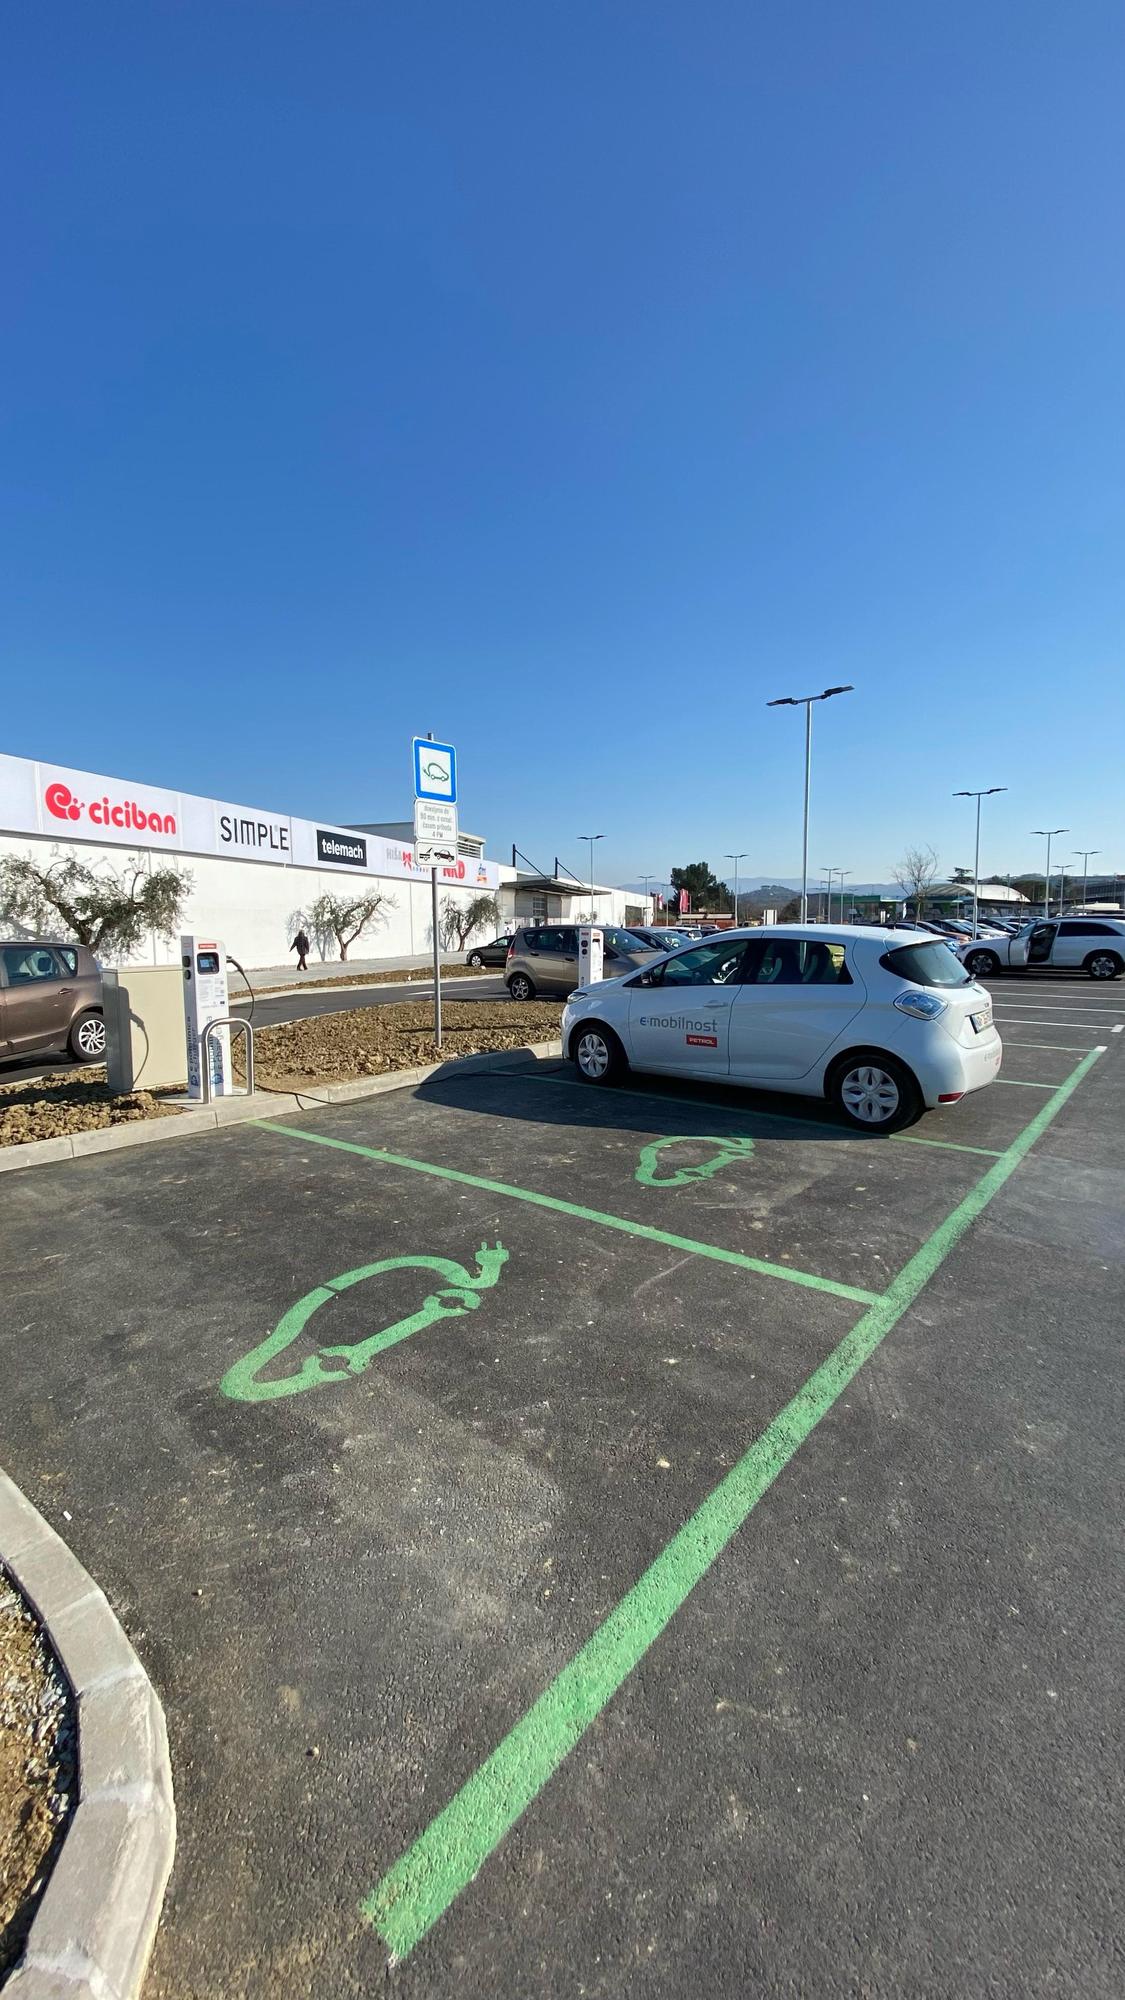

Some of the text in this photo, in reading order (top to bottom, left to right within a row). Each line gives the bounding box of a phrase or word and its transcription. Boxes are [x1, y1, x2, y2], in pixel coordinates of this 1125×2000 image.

[88, 797, 177, 835] ciciban
[220, 816, 290, 851] SIMPLE
[321, 838, 364, 860] telemach
